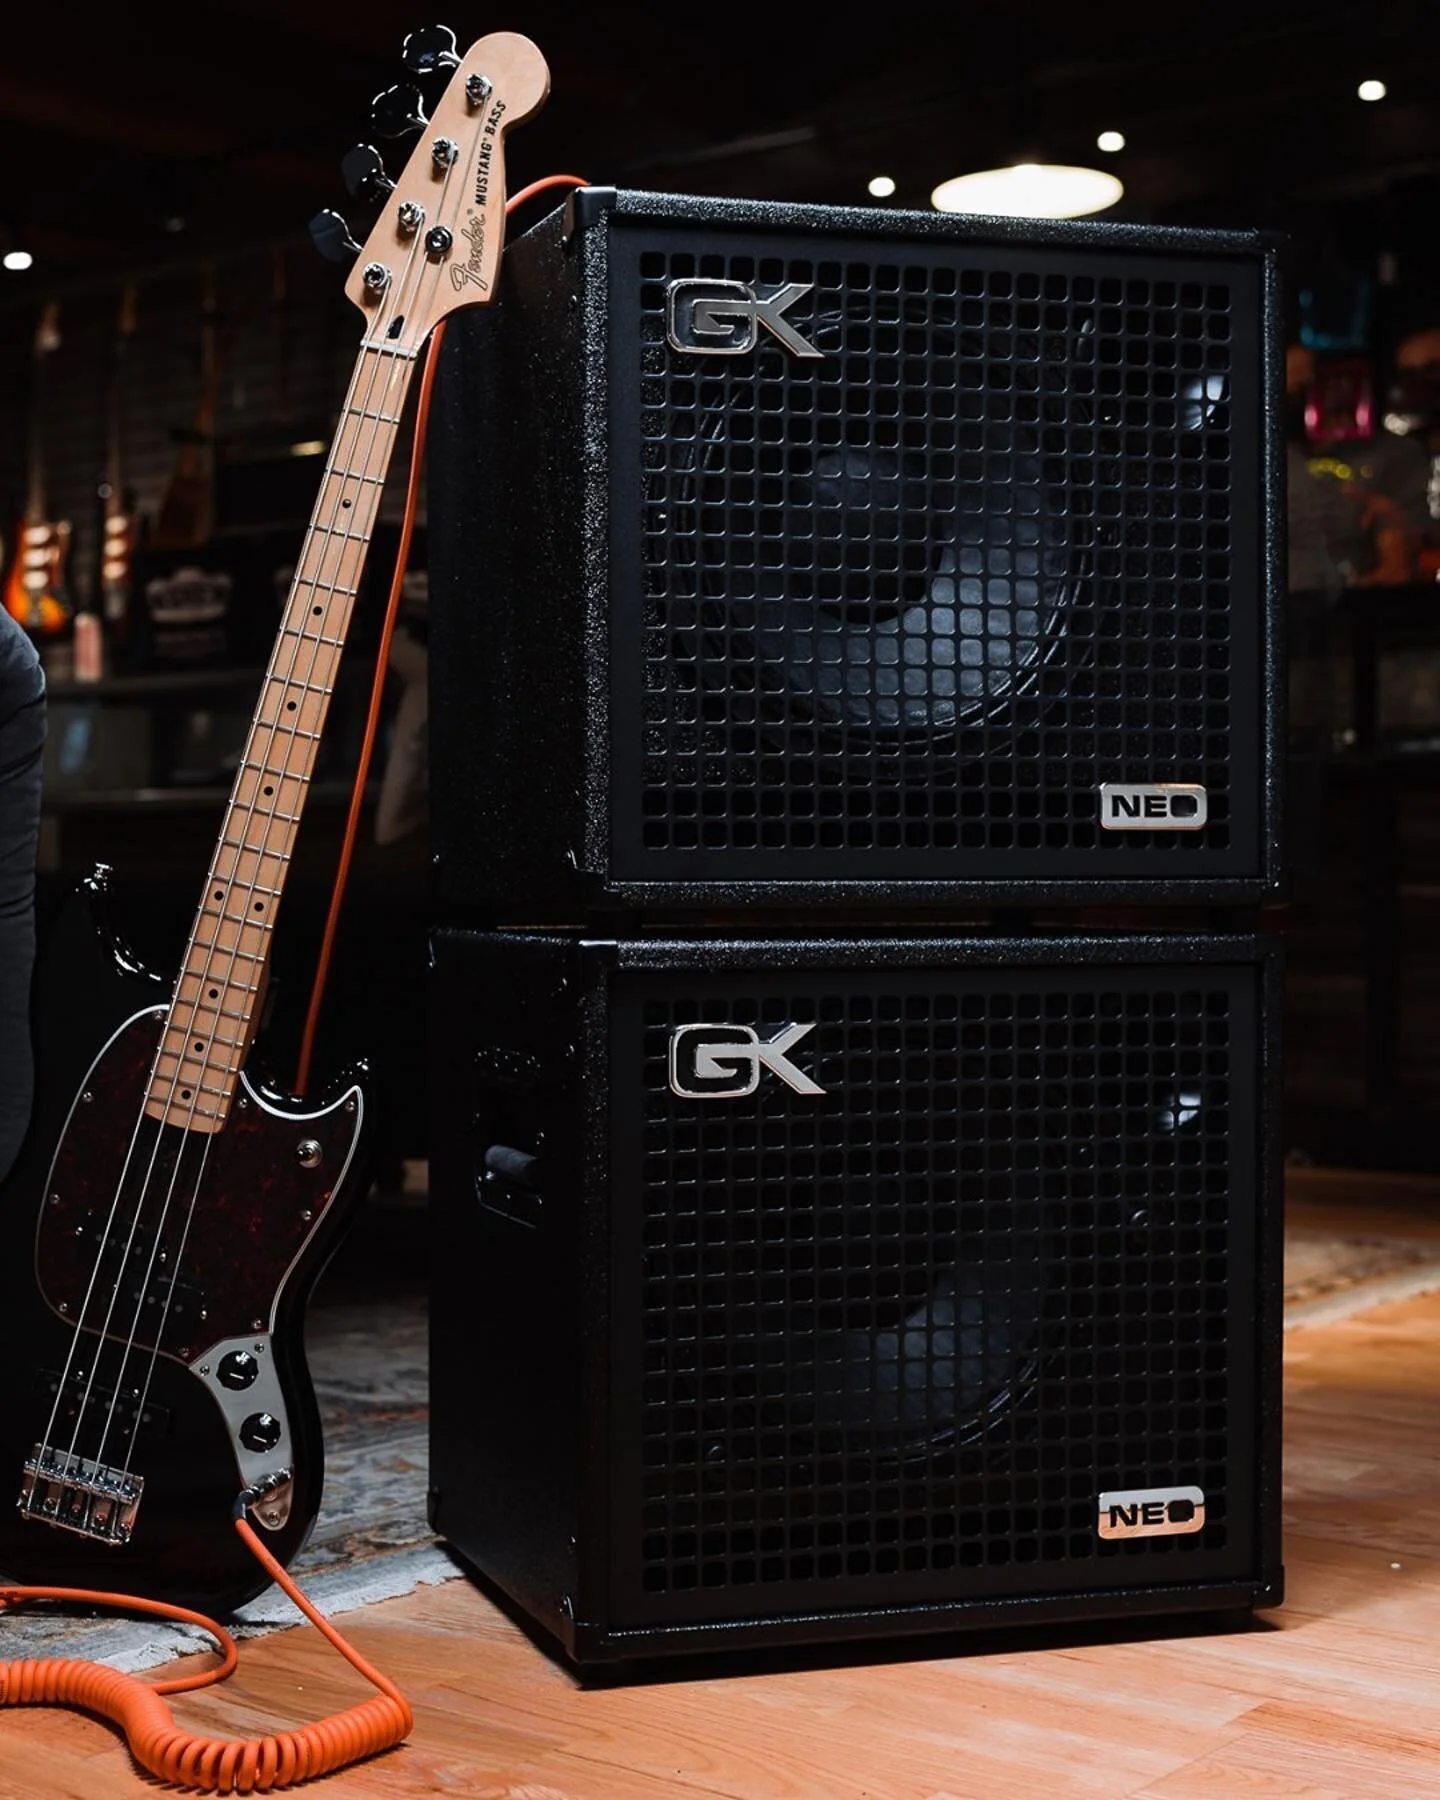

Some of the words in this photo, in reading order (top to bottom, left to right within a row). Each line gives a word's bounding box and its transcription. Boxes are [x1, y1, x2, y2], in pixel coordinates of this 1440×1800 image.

[488, 100, 506, 136] BASS
[450, 213, 488, 292] Fender
[666, 278, 825, 357] GK
[1111, 794, 1198, 818] NEO
[669, 1022, 827, 1098] GK
[1109, 1499, 1195, 1528] NEO
